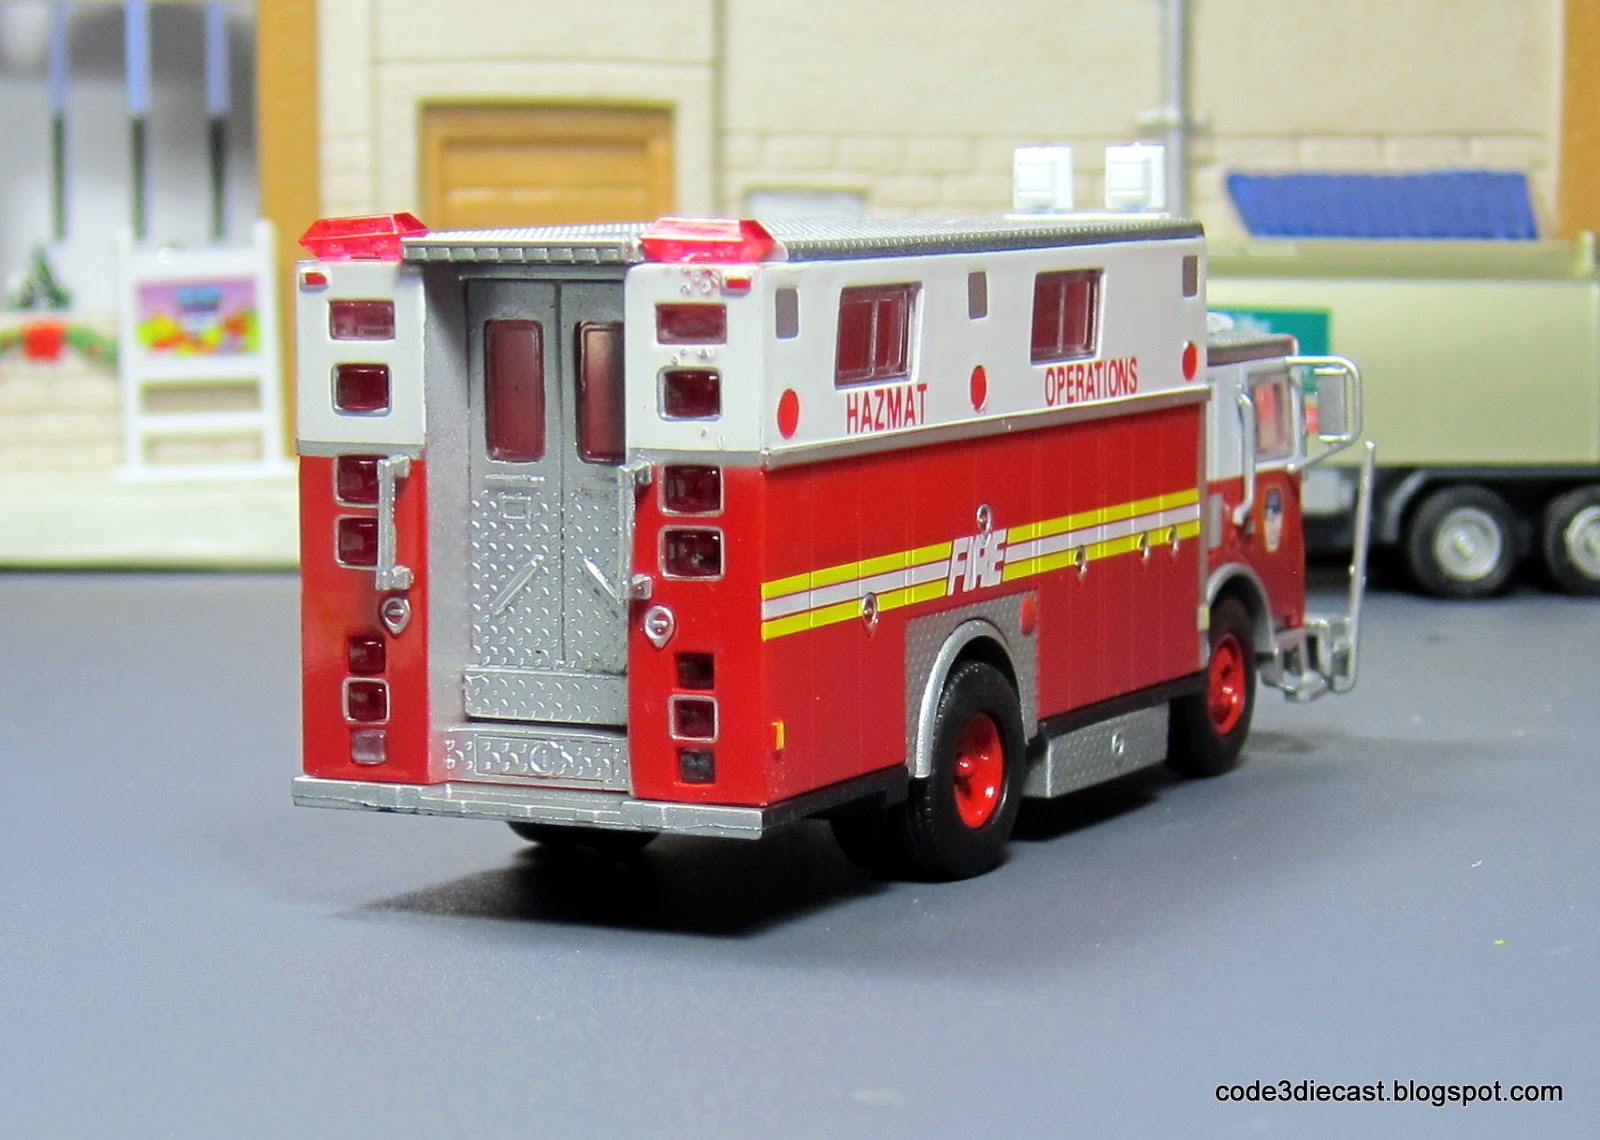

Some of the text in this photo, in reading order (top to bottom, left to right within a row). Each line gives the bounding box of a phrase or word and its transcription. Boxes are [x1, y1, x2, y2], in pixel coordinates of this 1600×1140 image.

[847, 357, 1137, 434] HAZMAT OPERATIONS
[947, 528, 1008, 595] FIRE
